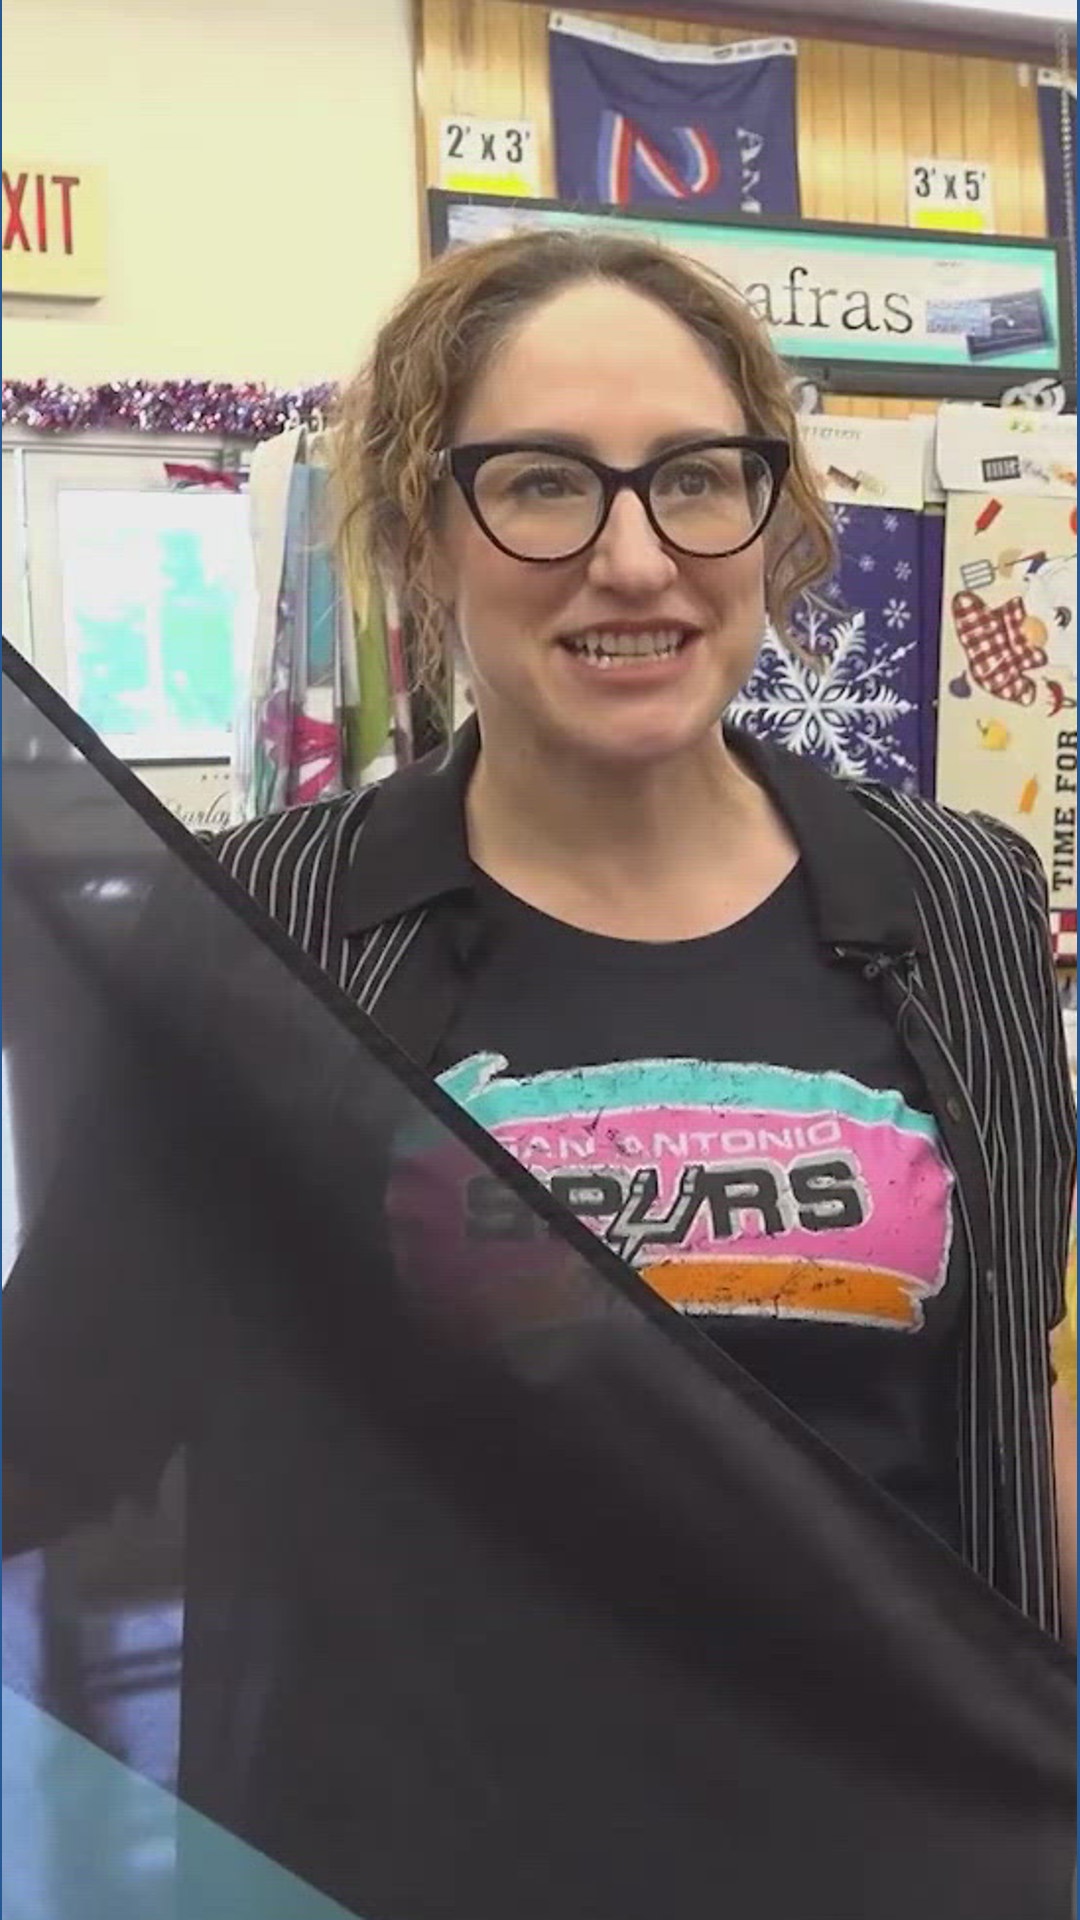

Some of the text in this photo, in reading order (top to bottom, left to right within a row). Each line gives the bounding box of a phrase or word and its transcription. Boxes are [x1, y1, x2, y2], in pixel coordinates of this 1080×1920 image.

[446, 124, 471, 158] 2'
[505, 129, 530, 163] 3'
[914, 167, 936, 197] 3'
[965, 170, 986, 201] 5'
[1053, 730, 1077, 892] TIME FOR
[611, 1118, 842, 1160] ANTONIO
